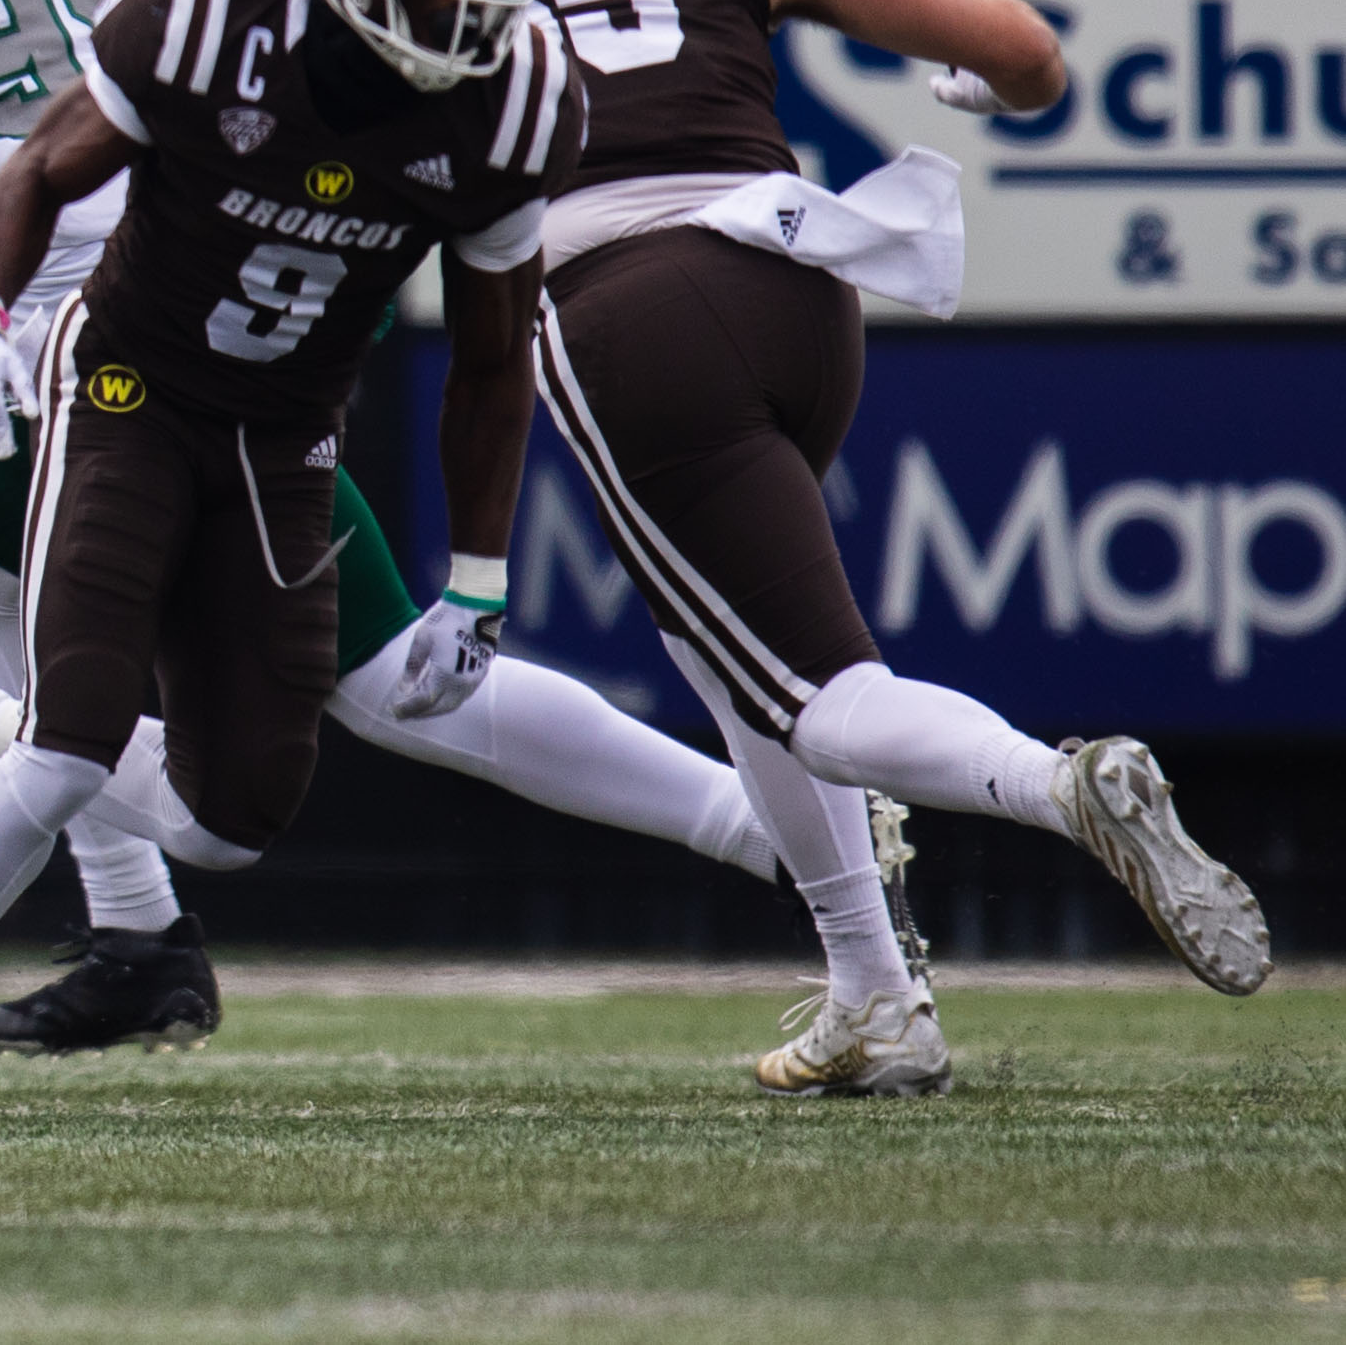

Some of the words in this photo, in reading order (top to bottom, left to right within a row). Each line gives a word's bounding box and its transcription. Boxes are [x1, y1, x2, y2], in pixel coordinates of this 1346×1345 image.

[236, 25, 275, 102] C
[315, 169, 347, 198] W
[219, 187, 412, 250] BRONCOS
[1117, 210, 1180, 284] &
[1251, 210, 1346, 286] So
[205, 243, 349, 364] 9
[100, 374, 136, 404] W
